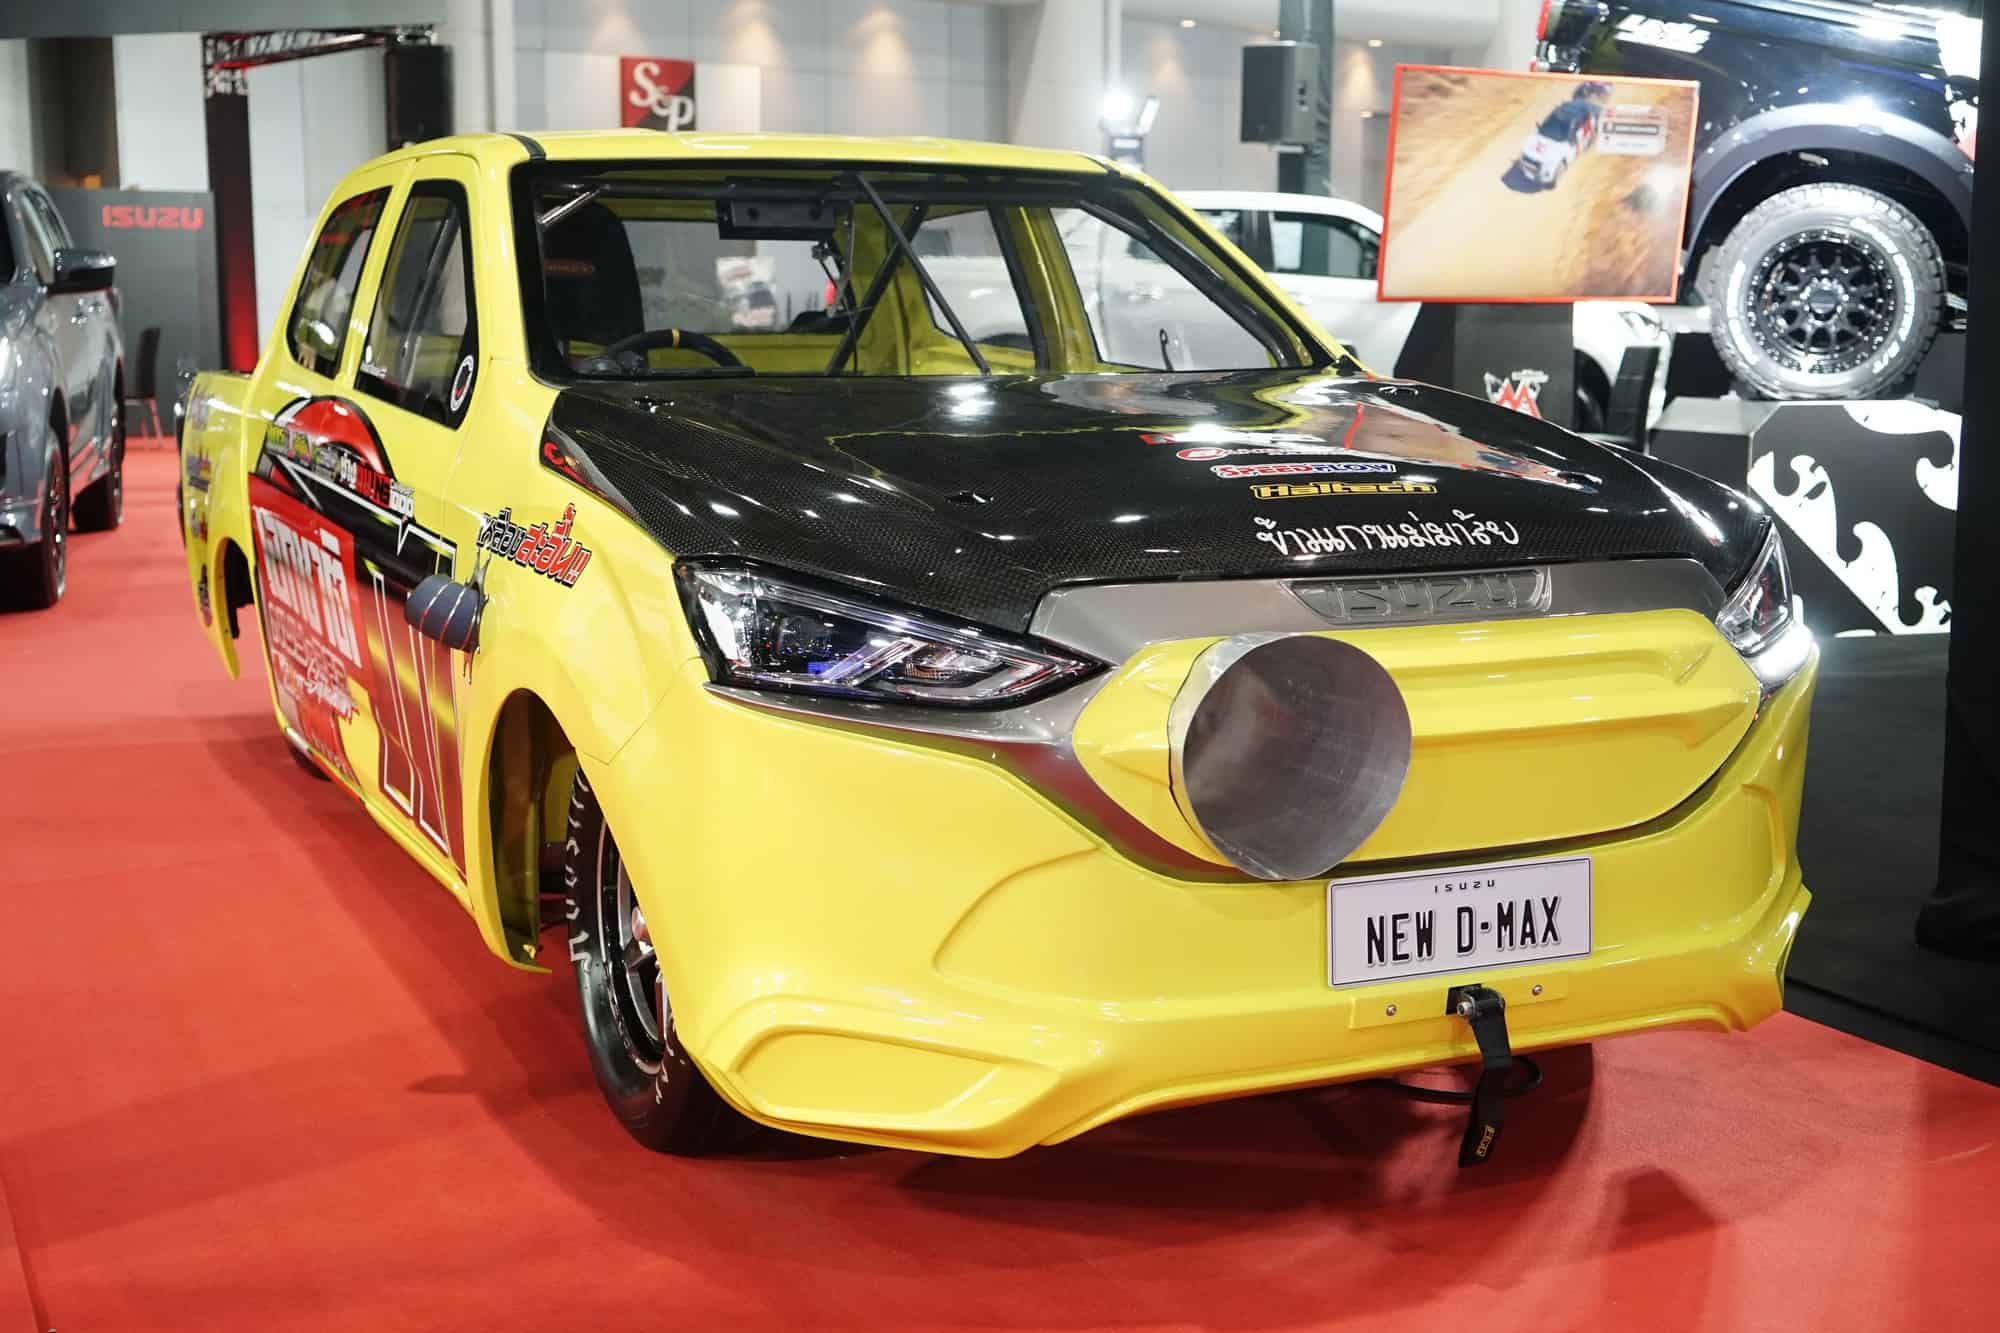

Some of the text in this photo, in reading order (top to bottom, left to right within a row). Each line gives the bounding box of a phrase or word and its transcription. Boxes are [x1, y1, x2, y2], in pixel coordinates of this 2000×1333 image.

[102, 205, 204, 231] ISUZU
[1215, 463, 1394, 477] SPEEDFLOW
[1255, 481, 1435, 498] Haltech
[1331, 573, 1519, 620] ISUZU
[1434, 879, 1496, 893] ISUZU
[1367, 896, 1560, 964] NEW D-MAX
